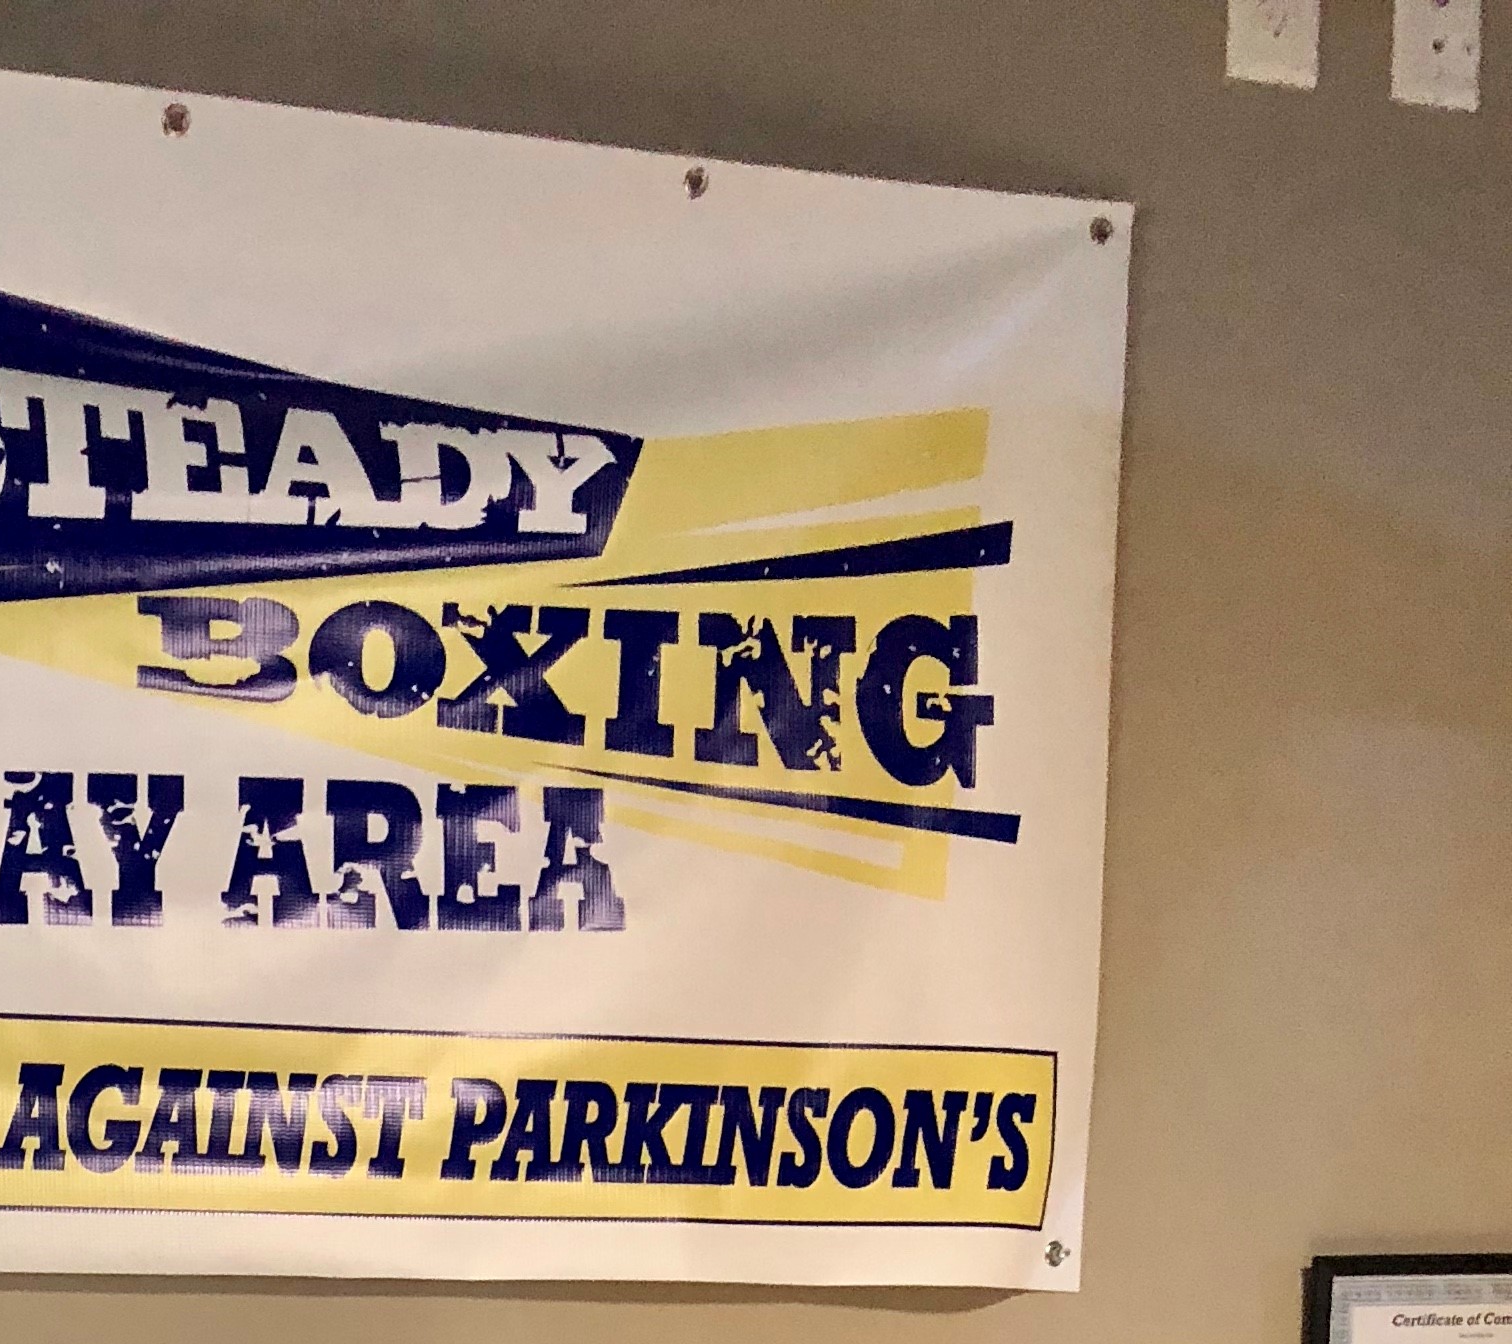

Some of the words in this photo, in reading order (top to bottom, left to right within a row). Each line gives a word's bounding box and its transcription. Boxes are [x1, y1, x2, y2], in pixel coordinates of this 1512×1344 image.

[136, 595, 994, 789] BOXING
[221, 776, 627, 932] AREA
[441, 1077, 1038, 1192] PARKINSON'S
[1392, 1313, 1463, 1327] Certificate
[1467, 1313, 1480, 1326] of
